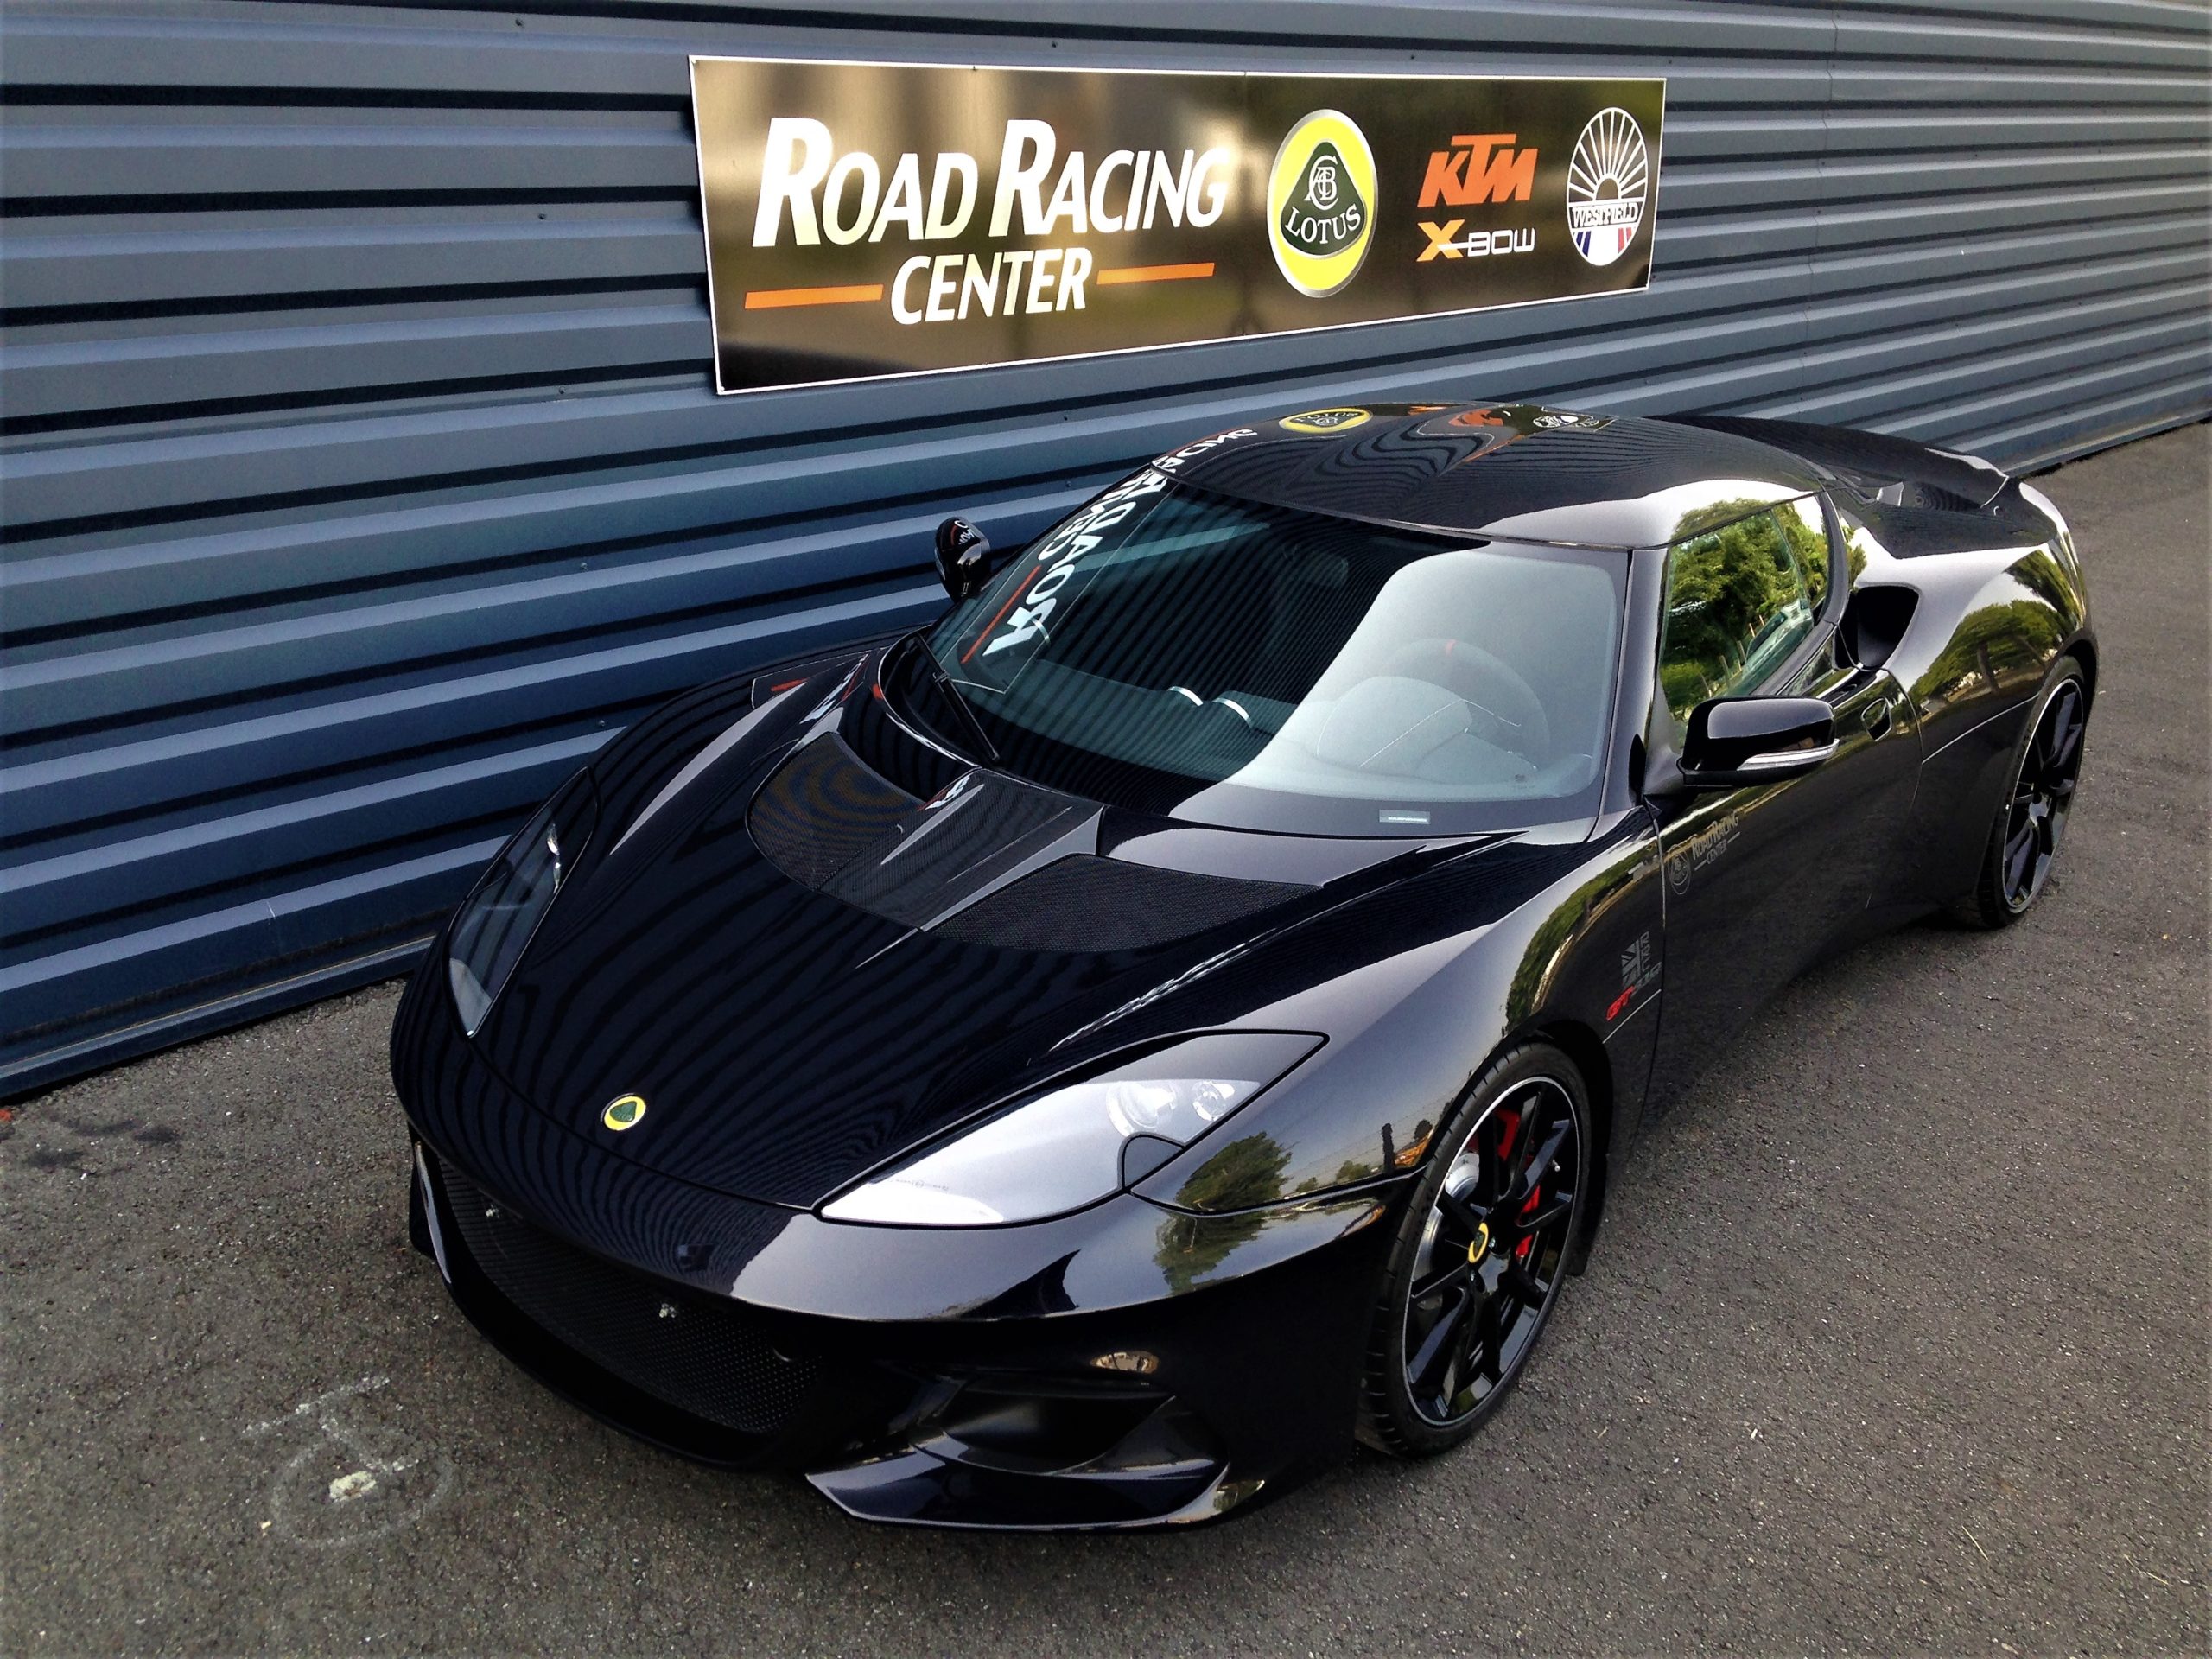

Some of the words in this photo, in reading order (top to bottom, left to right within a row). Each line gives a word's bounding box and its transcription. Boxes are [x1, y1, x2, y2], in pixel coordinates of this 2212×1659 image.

[1417, 134, 1539, 207] KTM
[1285, 204, 1361, 244] LOTUS
[1573, 201, 1639, 228] WESTFIELD
[891, 247, 1093, 325] CENTER
